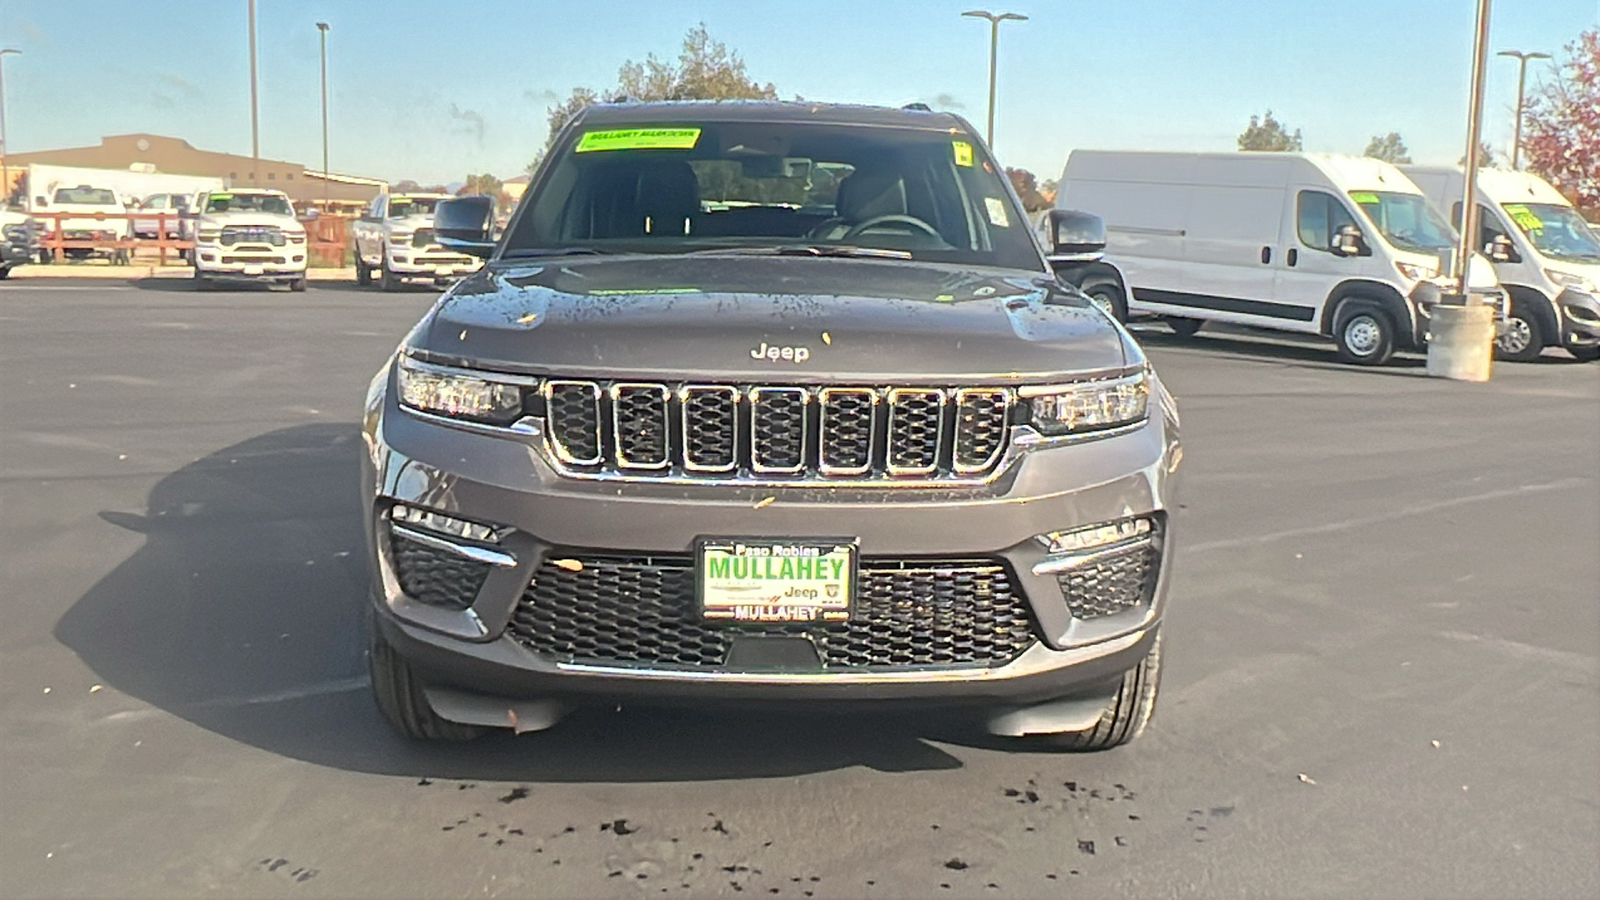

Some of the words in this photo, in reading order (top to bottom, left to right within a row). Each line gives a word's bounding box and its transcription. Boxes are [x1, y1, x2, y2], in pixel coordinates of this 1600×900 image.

[750, 342, 810, 363] Jeep
[735, 544, 770, 556] Paso
[772, 545, 820, 557] Robles
[709, 557, 844, 580] MULLAHEY
[784, 586, 819, 600] Jeep
[735, 605, 819, 620] MULLAHEY
